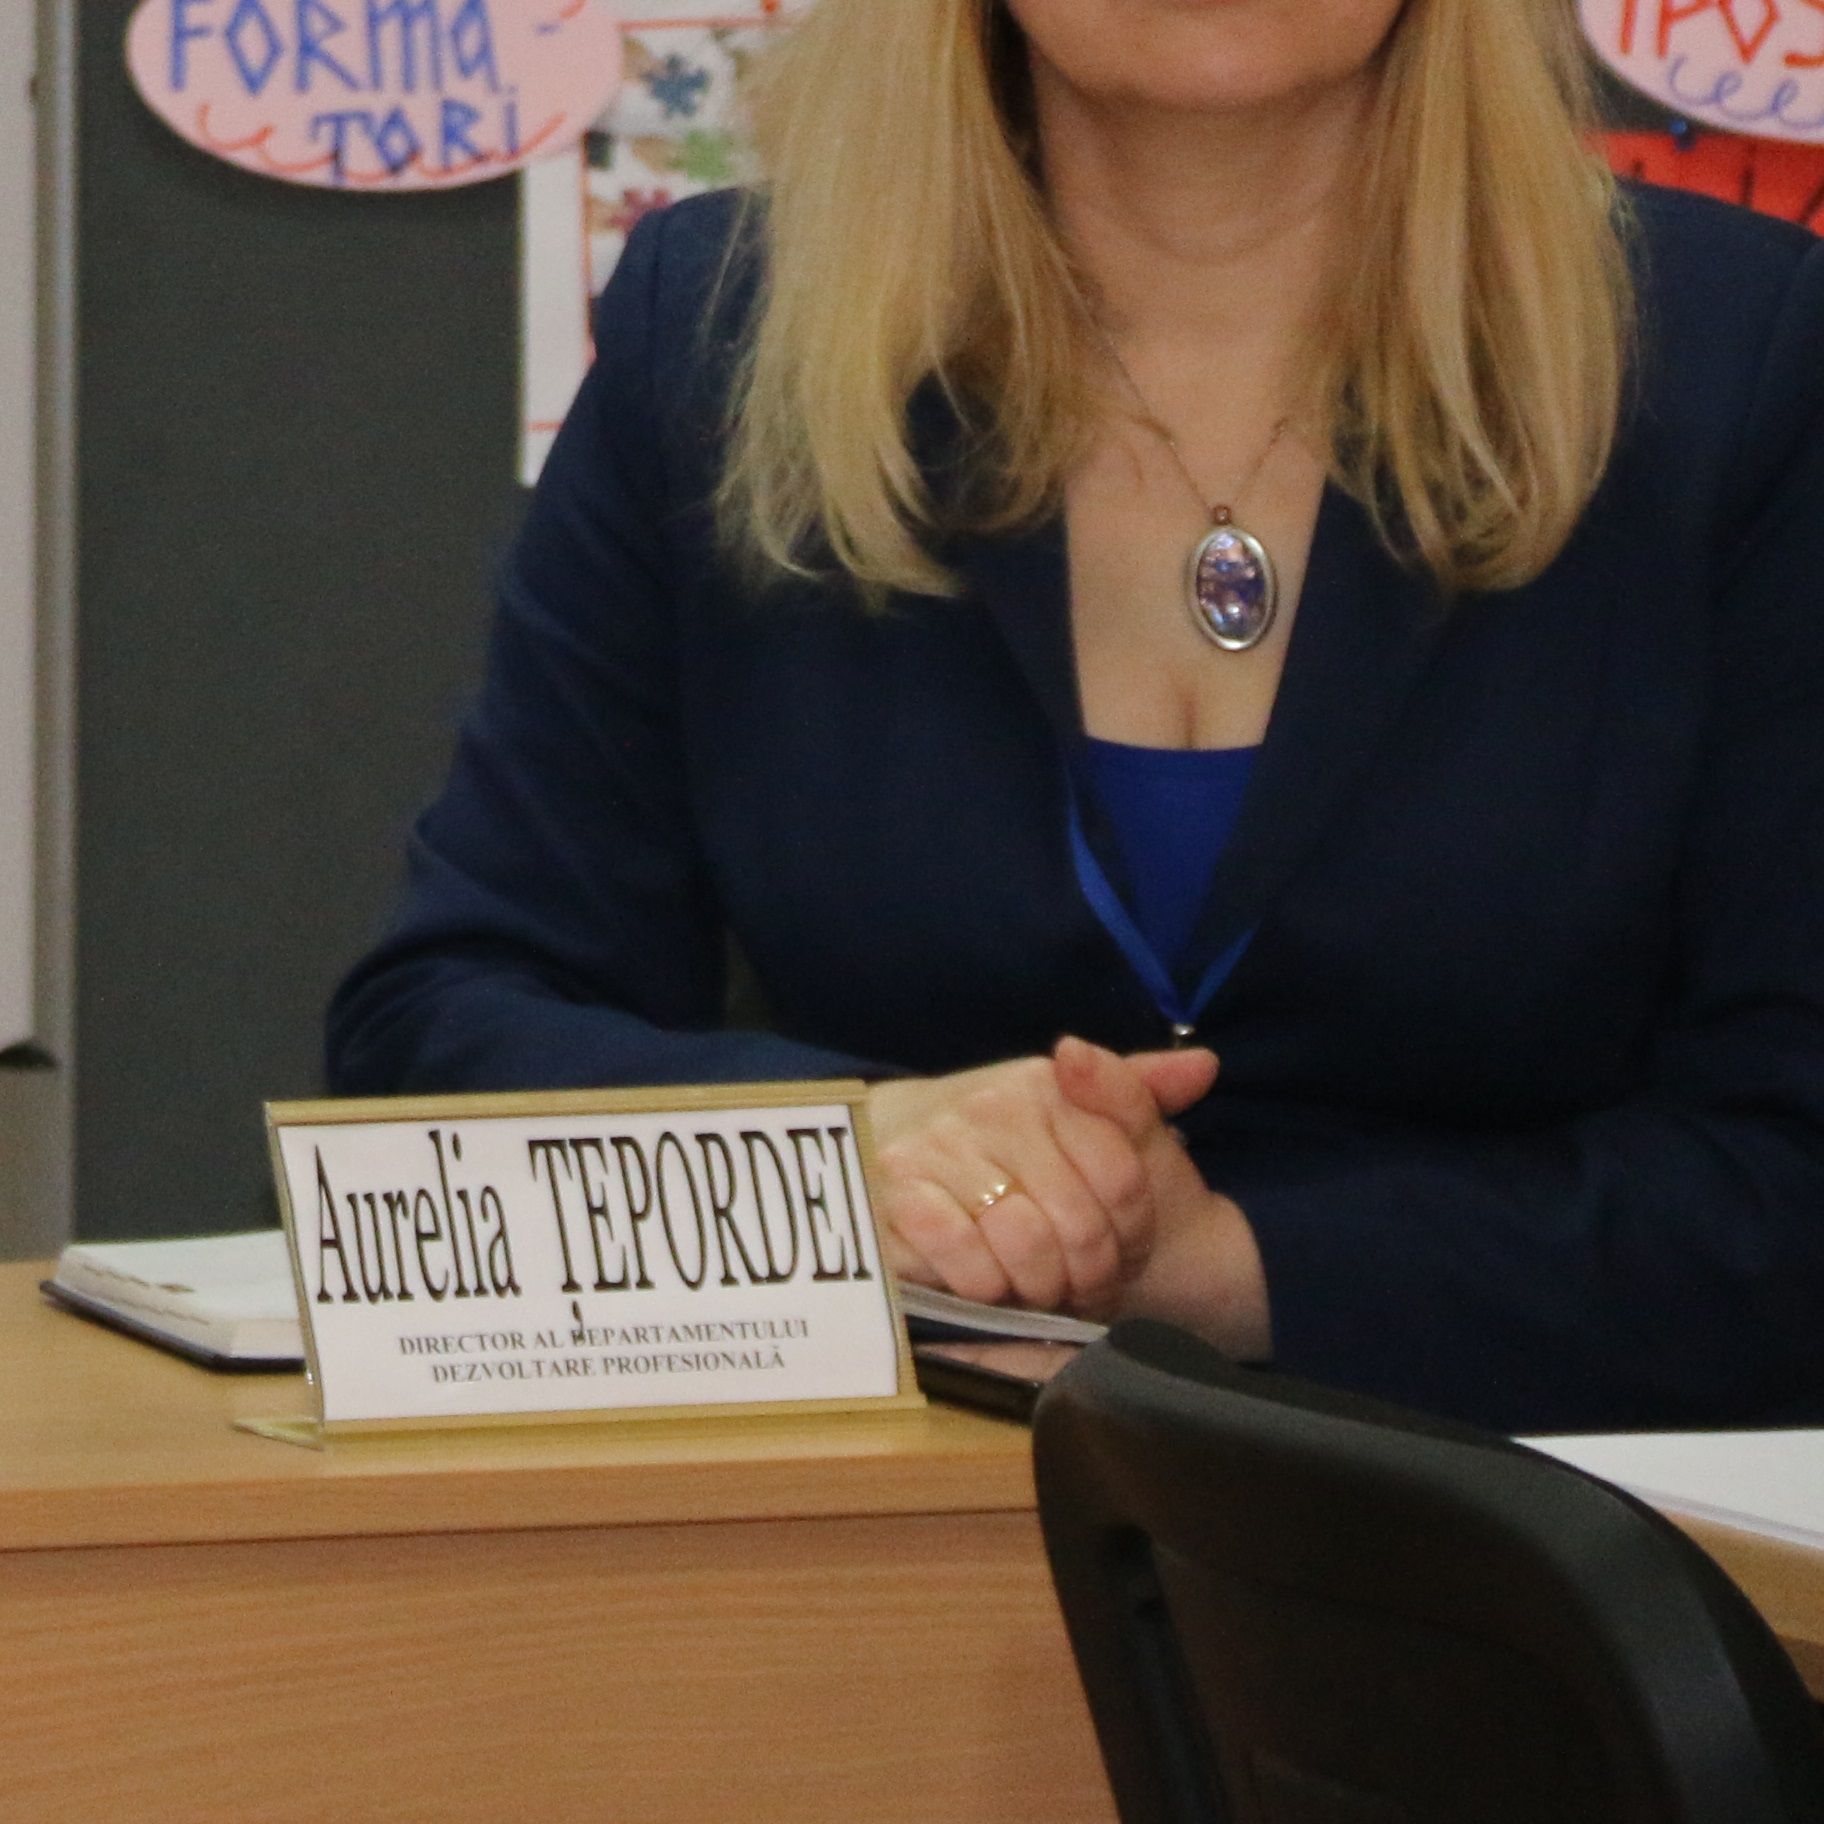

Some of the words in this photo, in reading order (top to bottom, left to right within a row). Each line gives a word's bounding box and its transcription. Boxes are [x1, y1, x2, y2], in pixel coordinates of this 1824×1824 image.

[316, 1129, 522, 1304] Aurelia
[399, 1330, 525, 1357] DIRECTOR
[534, 1328, 563, 1349] AL
[572, 1319, 810, 1347] DEPARTAMENTULUI
[432, 1358, 595, 1384] DEZVOLTARE
[603, 1345, 786, 1376] PROFESIONALĂ
